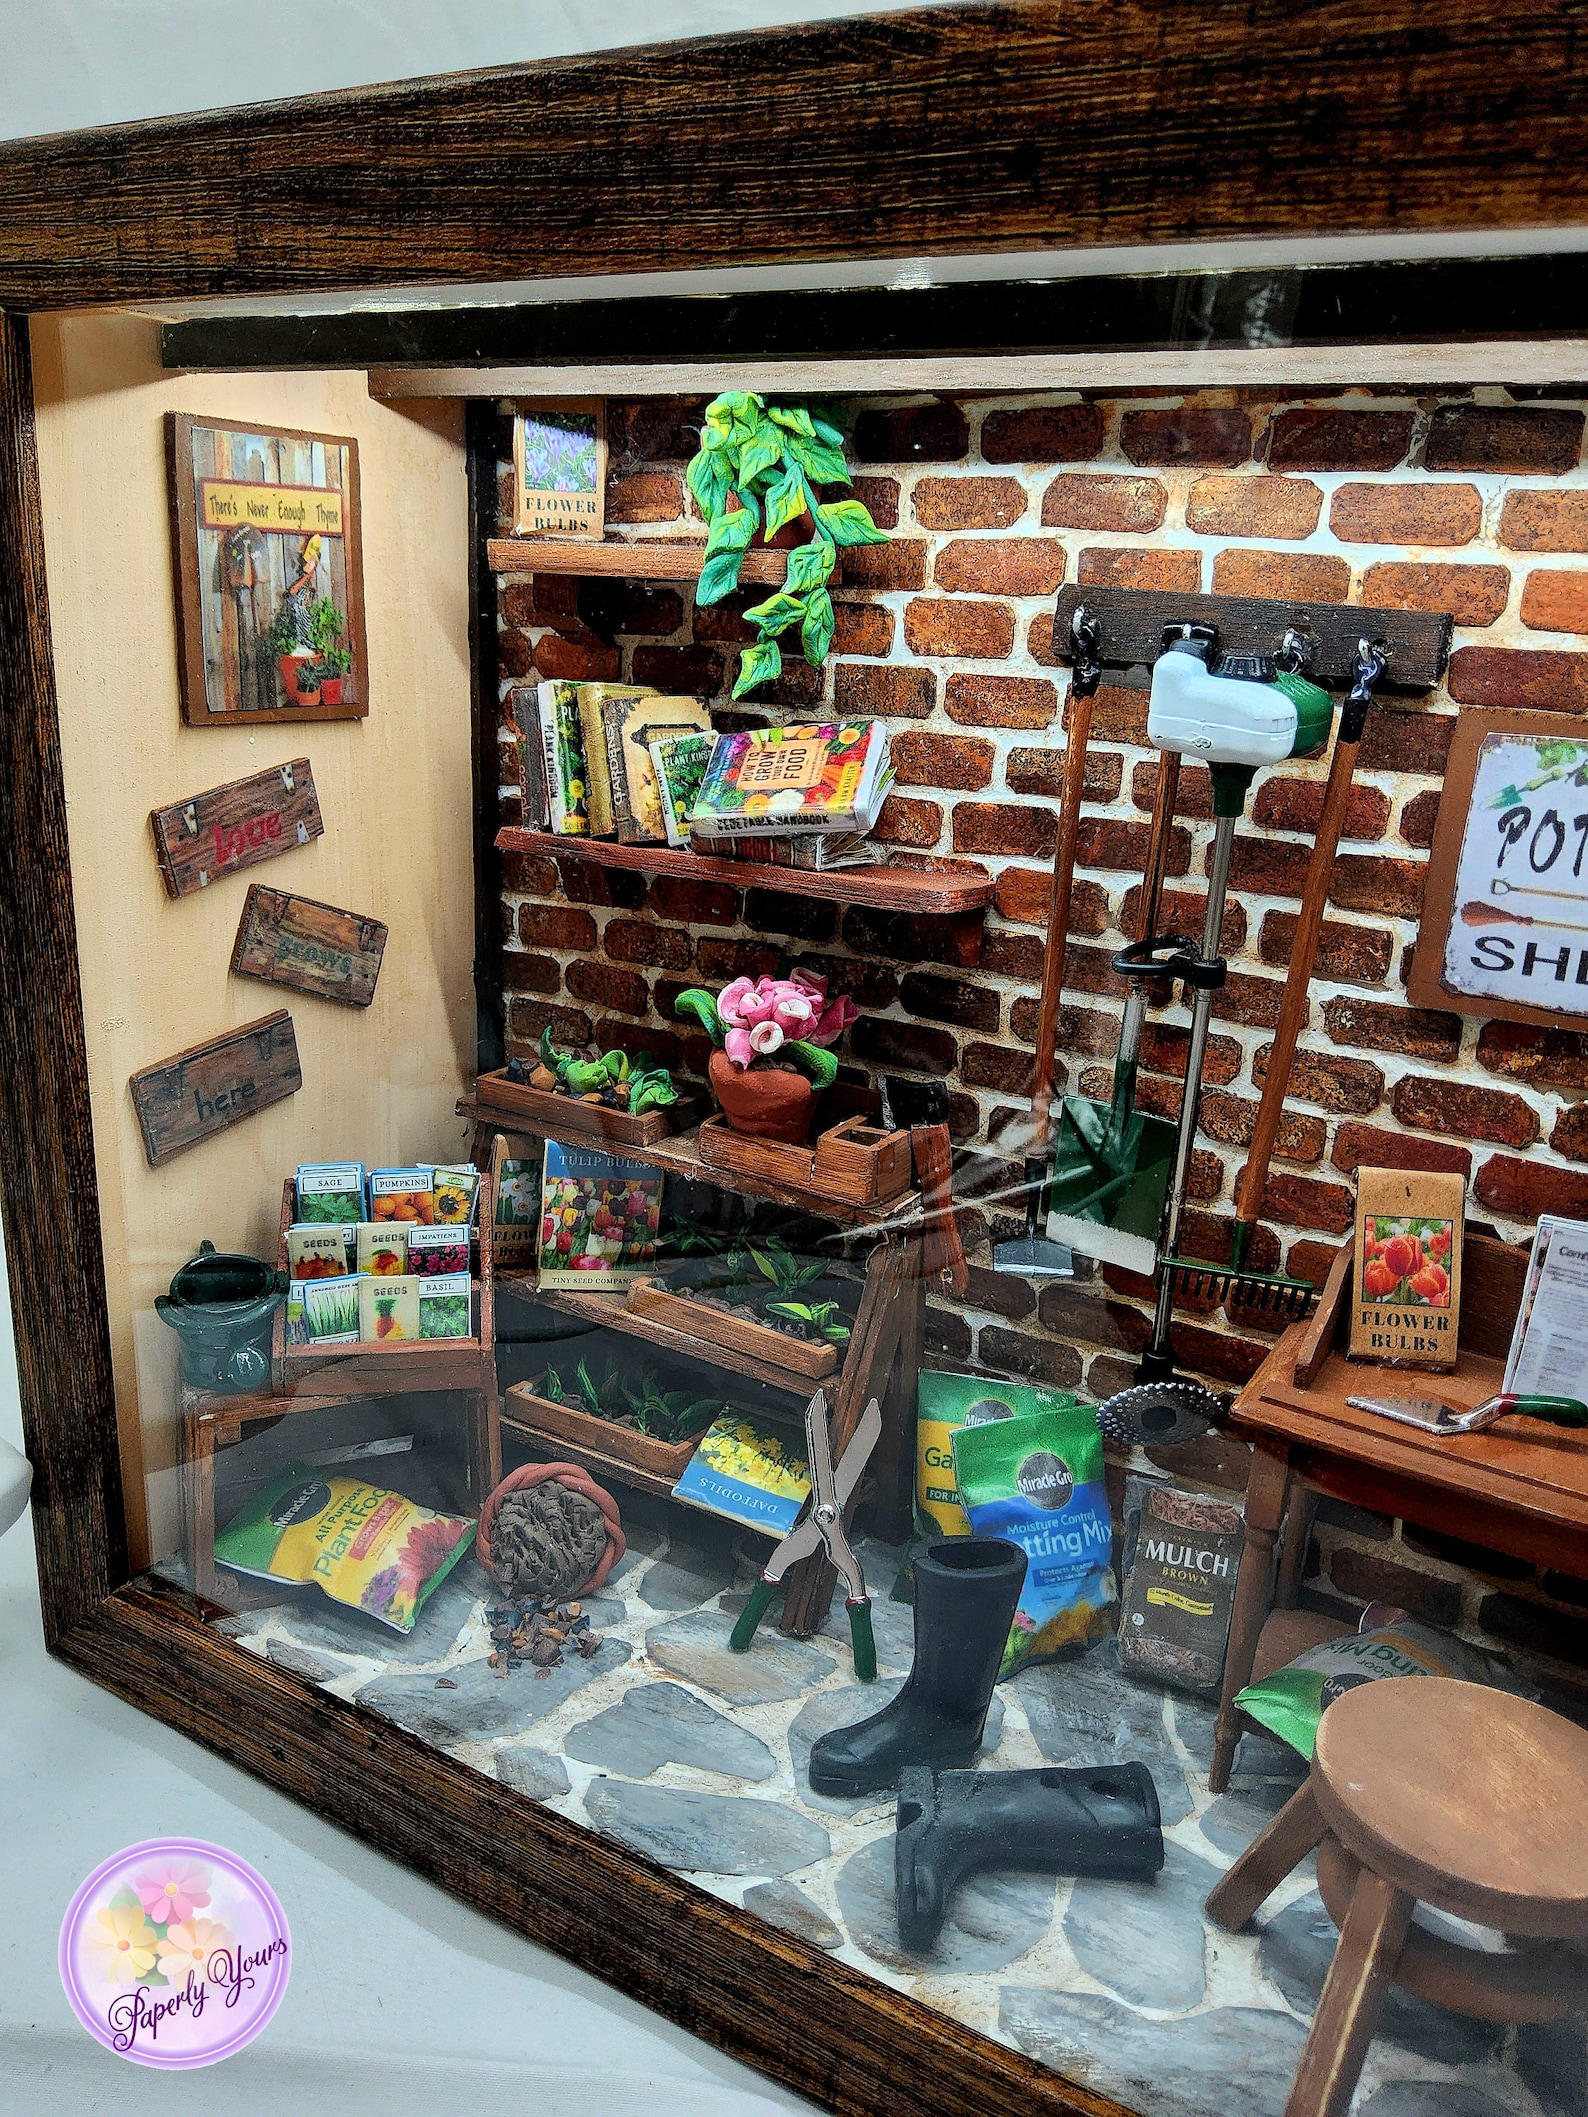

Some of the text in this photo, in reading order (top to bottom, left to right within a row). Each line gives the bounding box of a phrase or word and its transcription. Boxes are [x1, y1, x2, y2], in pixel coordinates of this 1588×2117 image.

[209, 494, 338, 530] There's Never Enough Thyme
[525, 497, 597, 513] FLOWER
[534, 517, 589, 531] BULBS
[606, 726, 624, 805] GARDENS
[664, 754, 689, 766] PLANT
[740, 751, 759, 782] HOW TO
[754, 750, 777, 781] GROW
[783, 748, 807, 780] FOOD
[194, 1077, 258, 1122] here
[559, 1155, 601, 1168] TULIP
[318, 1178, 343, 1187] SAGE
[379, 1178, 426, 1188] PUMPKINS
[302, 1238, 338, 1249] SEEDS
[371, 1233, 405, 1243] SEEDS
[418, 1232, 458, 1241] IMPATIENS
[373, 1286, 408, 1297] SEEDS
[425, 1282, 455, 1292] BASIL
[1361, 1310, 1450, 1331] FLOWER
[1371, 1333, 1439, 1351] BULBS
[700, 1477, 779, 1514] DAFFODILS
[929, 1489, 949, 1500] FOR
[315, 1524, 333, 1544] All
[328, 1487, 367, 1525] Purpose
[1007, 1508, 1096, 1535] Moisture Control
[1082, 1520, 1113, 1547] Mix
[313, 1518, 363, 1577] Plant
[1145, 1539, 1229, 1578] MULCH
[1162, 1566, 1209, 1586] BROWN
